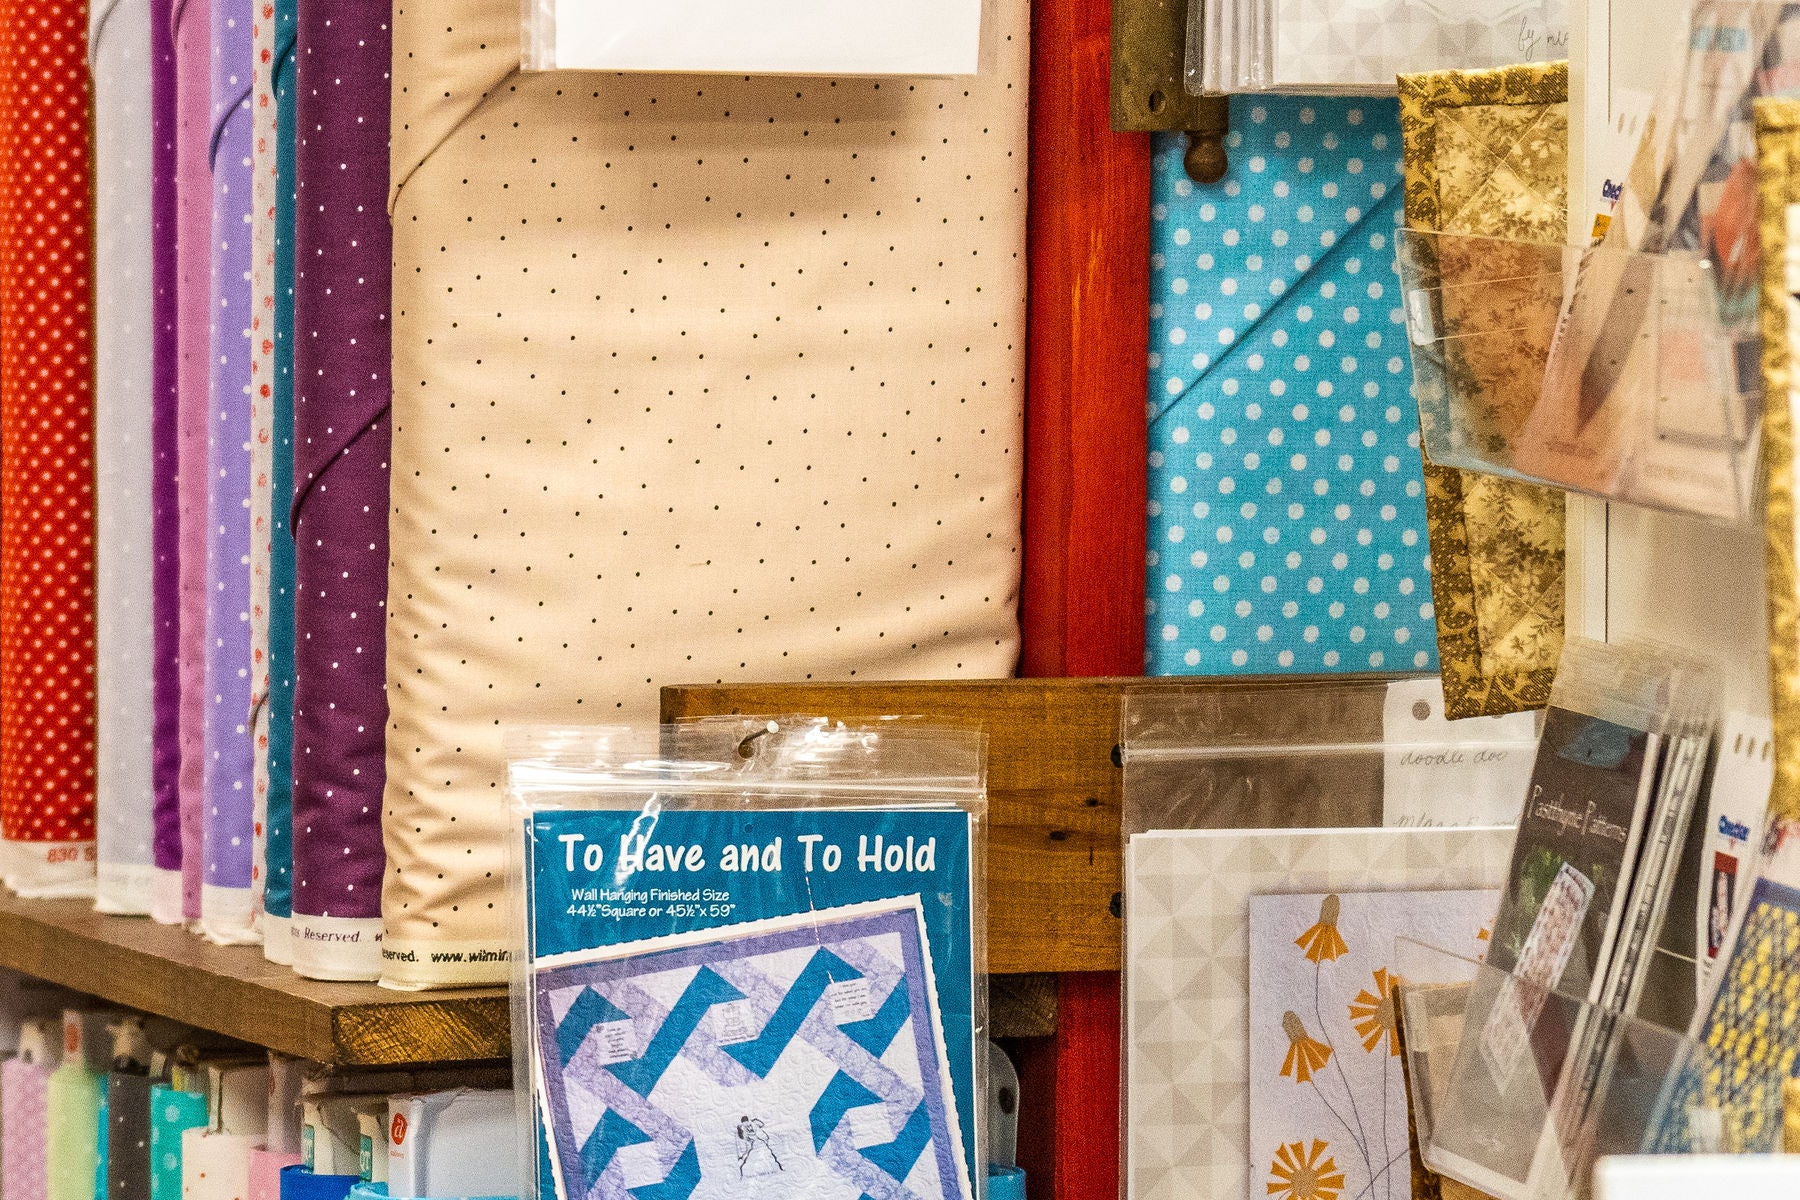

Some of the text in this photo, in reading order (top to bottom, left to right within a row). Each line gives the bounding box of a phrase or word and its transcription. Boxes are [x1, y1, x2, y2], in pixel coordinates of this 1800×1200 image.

[1517, 16, 1542, 62] by
[557, 833, 937, 873] To Have and To Hold
[571, 888, 730, 904] Wall Hanging Finished Size
[648, 908, 663, 917] or
